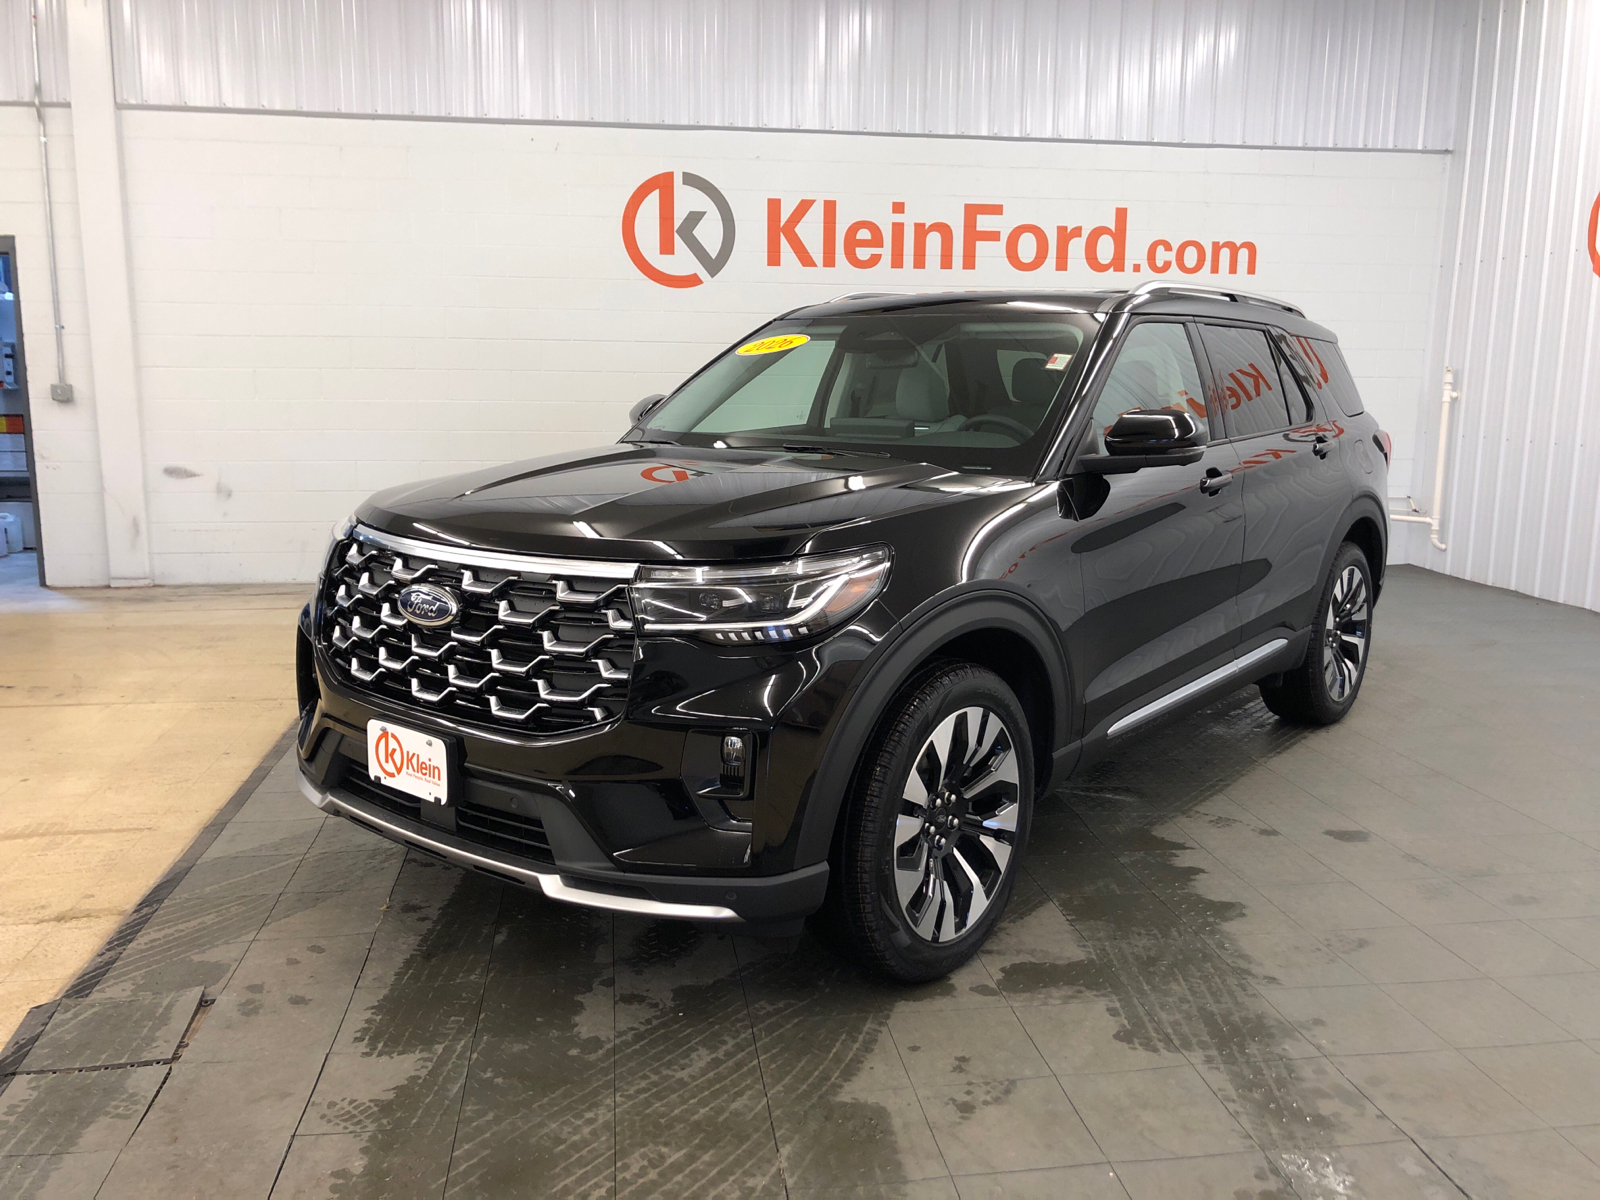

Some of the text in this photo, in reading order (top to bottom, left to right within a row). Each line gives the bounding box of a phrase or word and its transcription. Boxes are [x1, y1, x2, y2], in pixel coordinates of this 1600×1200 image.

[767, 198, 1257, 275] KleinFord.com
[743, 337, 799, 353] 2026
[407, 592, 437, 617] Ford
[405, 750, 441, 781] Klein
